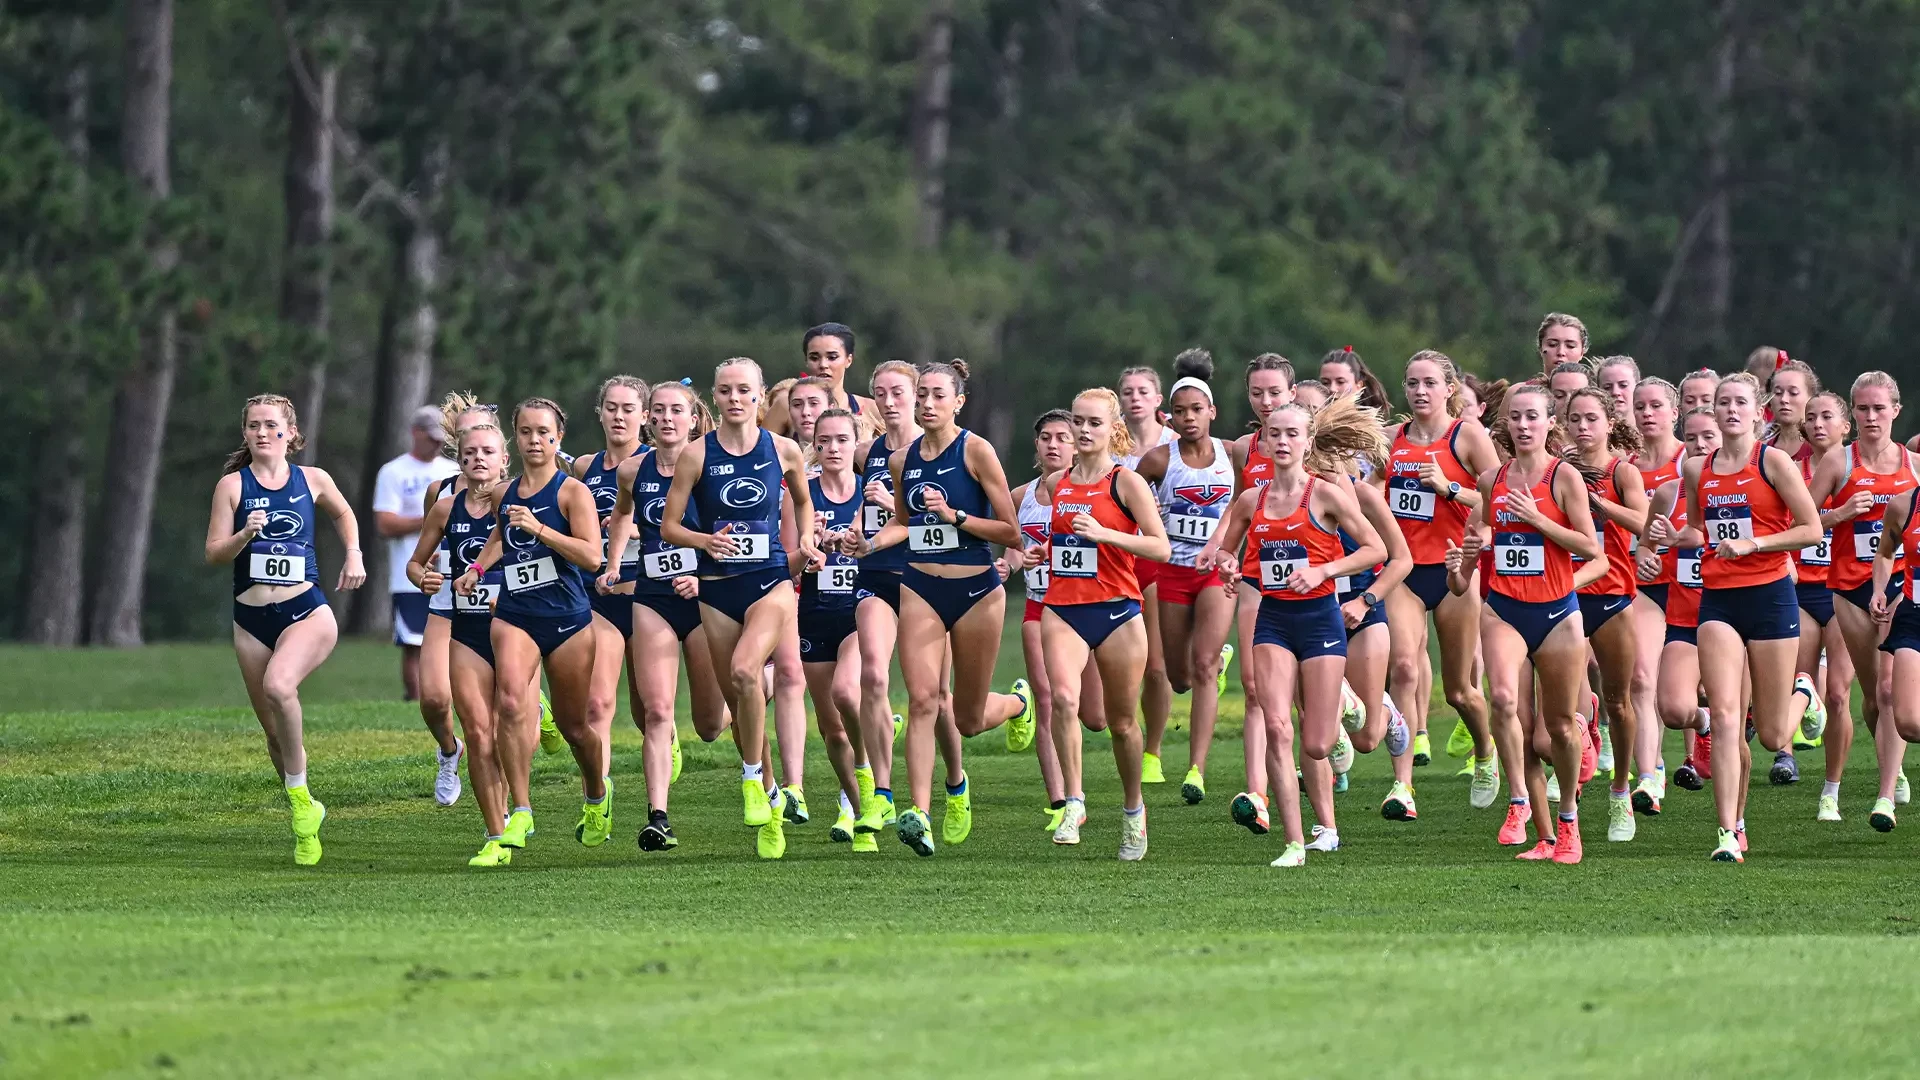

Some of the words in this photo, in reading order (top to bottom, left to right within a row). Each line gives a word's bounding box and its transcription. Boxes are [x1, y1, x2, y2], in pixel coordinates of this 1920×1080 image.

[1250, 463, 1267, 473] ACC
[1392, 459, 1421, 477] Syrac
[1703, 480, 1720, 489] ACC
[1056, 500, 1093, 517] Syracuse
[1399, 492, 1421, 512] 80
[1707, 493, 1748, 507] Syracuse
[1177, 517, 1208, 537] 111
[1254, 524, 1270, 532] ACC
[1717, 522, 1740, 540] 88
[923, 528, 944, 546] 49
[1869, 536, 1881, 554] 9
[265, 558, 290, 577] 60
[658, 553, 683, 573] 58
[1061, 550, 1083, 569] 84
[1505, 549, 1529, 568] 96
[517, 563, 539, 585] 57
[833, 569, 857, 587] 59
[1272, 563, 1294, 582] 94
[1691, 562, 1703, 580] 9
[467, 588, 489, 606] 62
